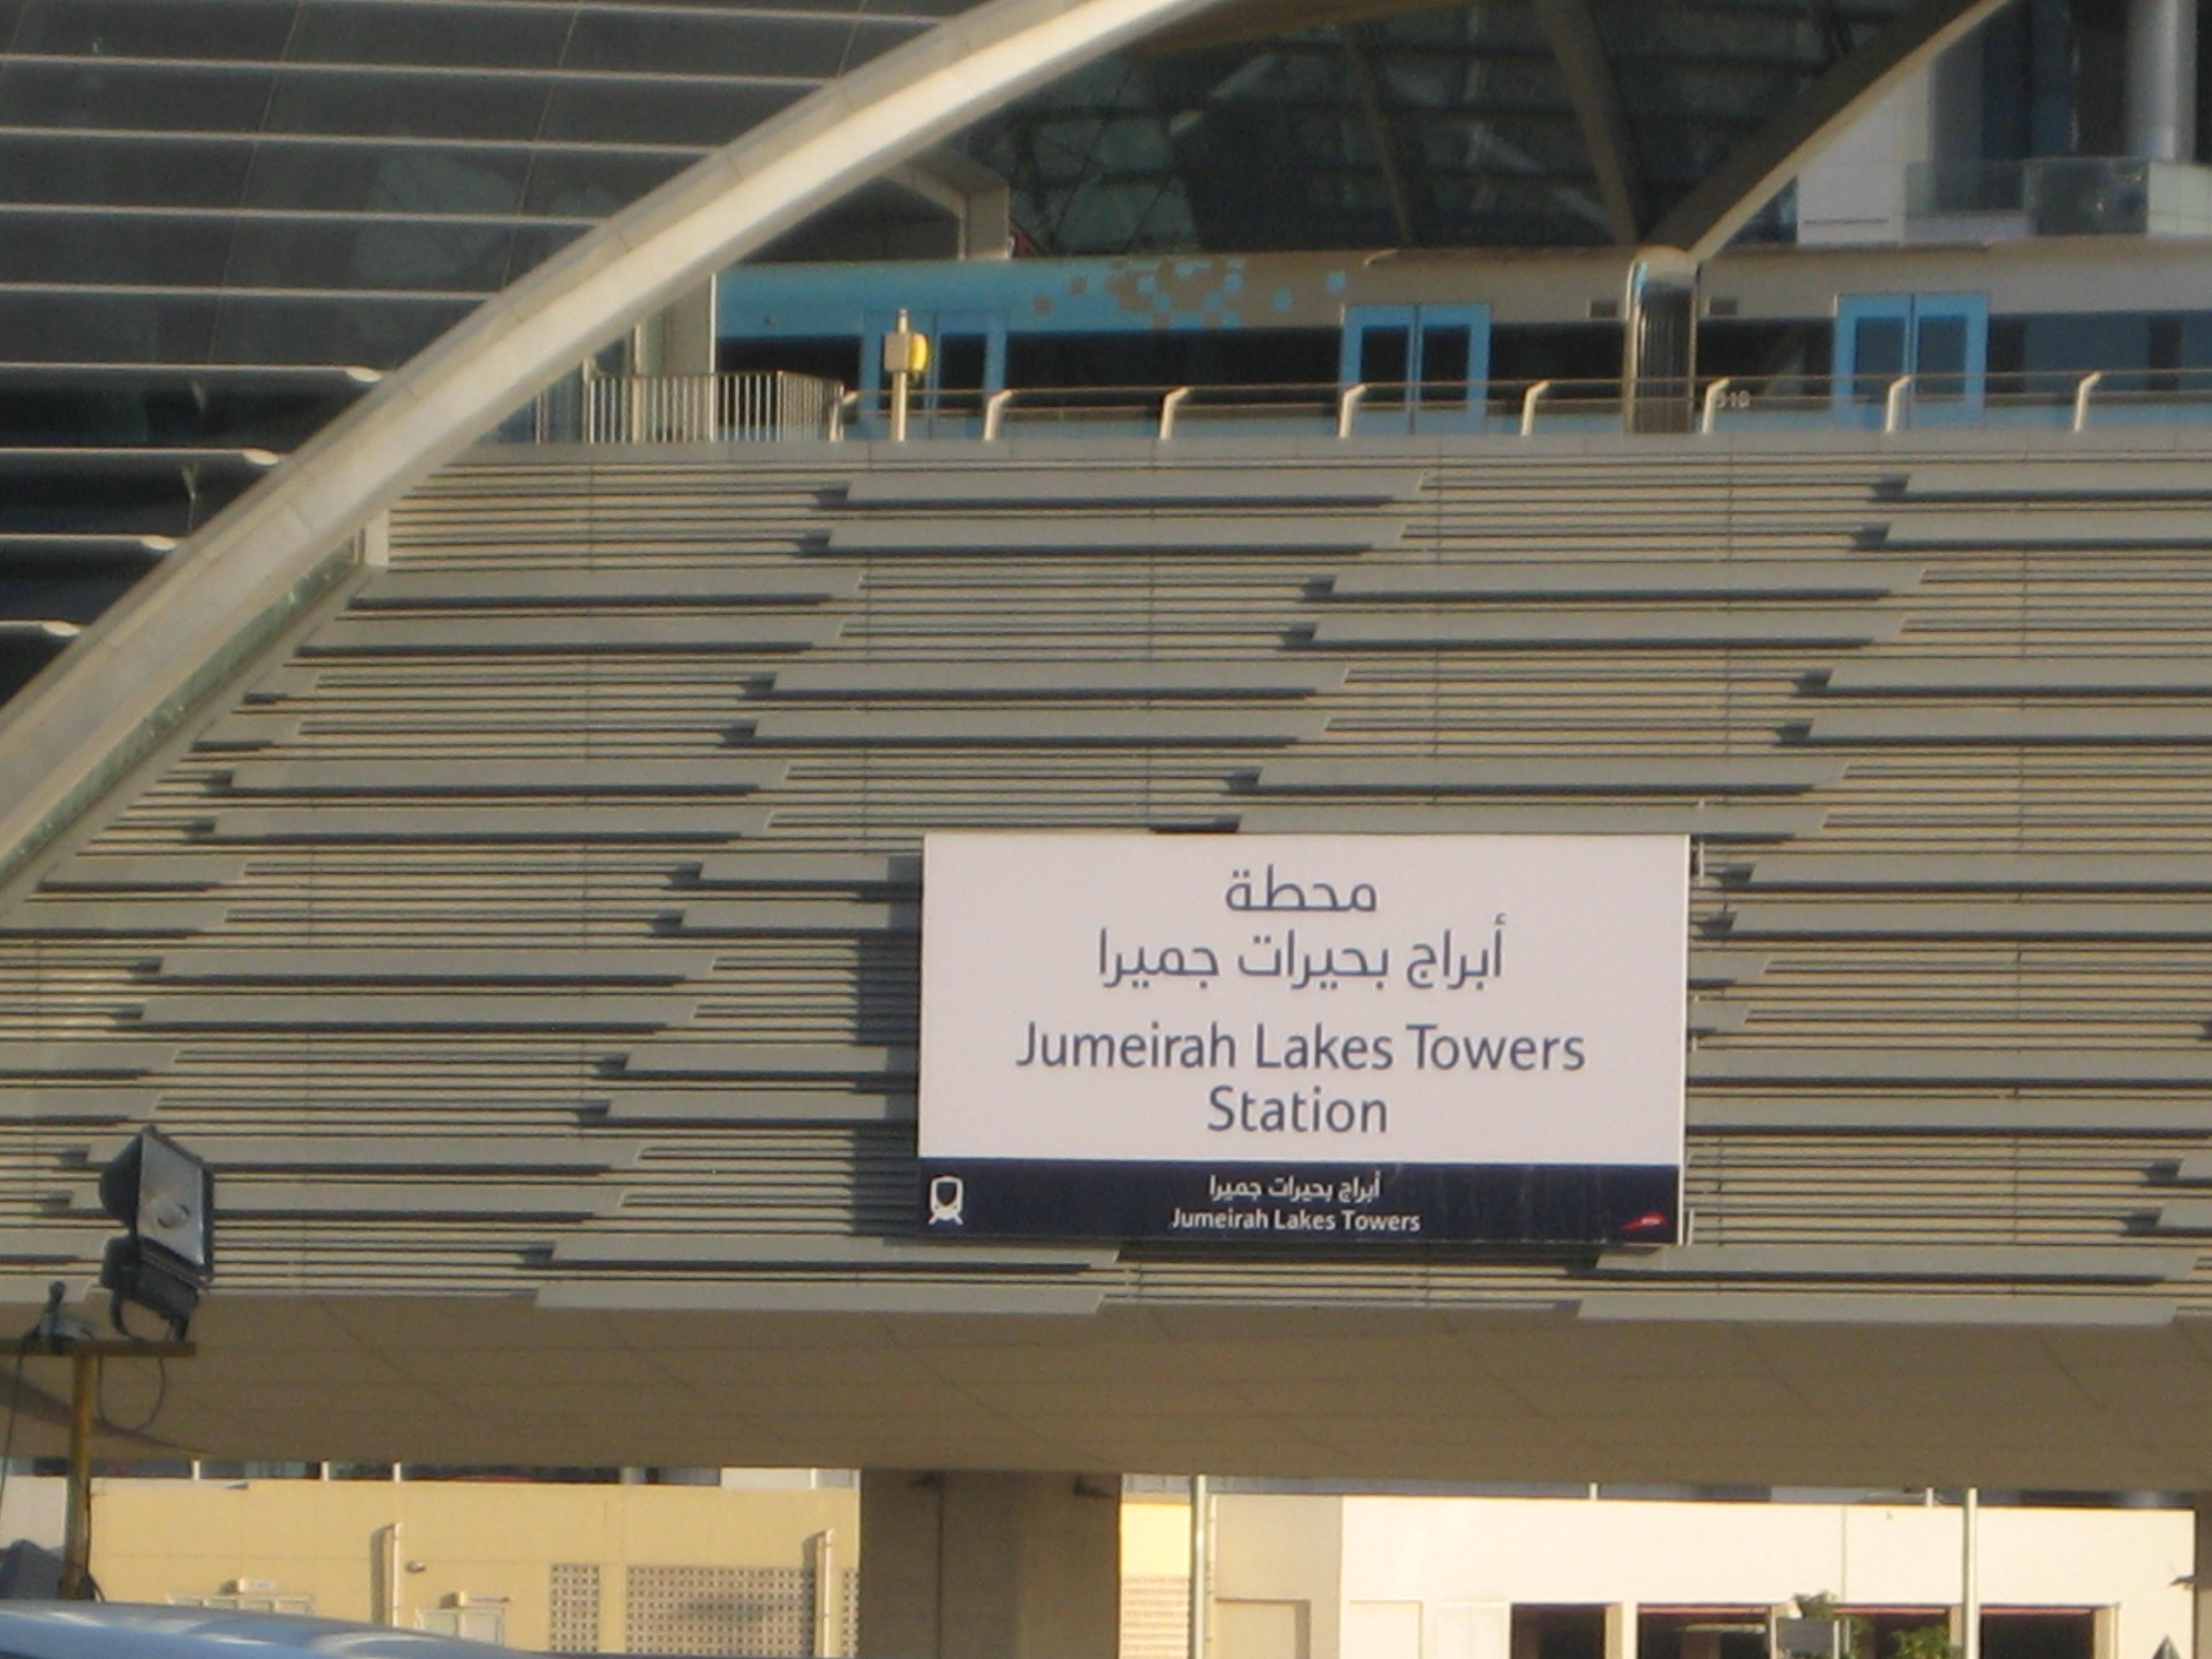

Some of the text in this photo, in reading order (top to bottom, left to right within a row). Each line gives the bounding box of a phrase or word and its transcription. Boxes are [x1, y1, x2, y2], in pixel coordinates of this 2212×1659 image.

[1225, 863, 1377, 913] محطة
[1100, 913, 1506, 991] أبراج بحيرات جميرا
[1015, 1020, 1585, 1071] Jumeirah Lakes Towers
[1208, 1084, 1387, 1133] Station
[1209, 1169, 1381, 1204] أبراج بحيرات جميرا
[1172, 1207, 1421, 1232] Jumeirah Lakes Towers
